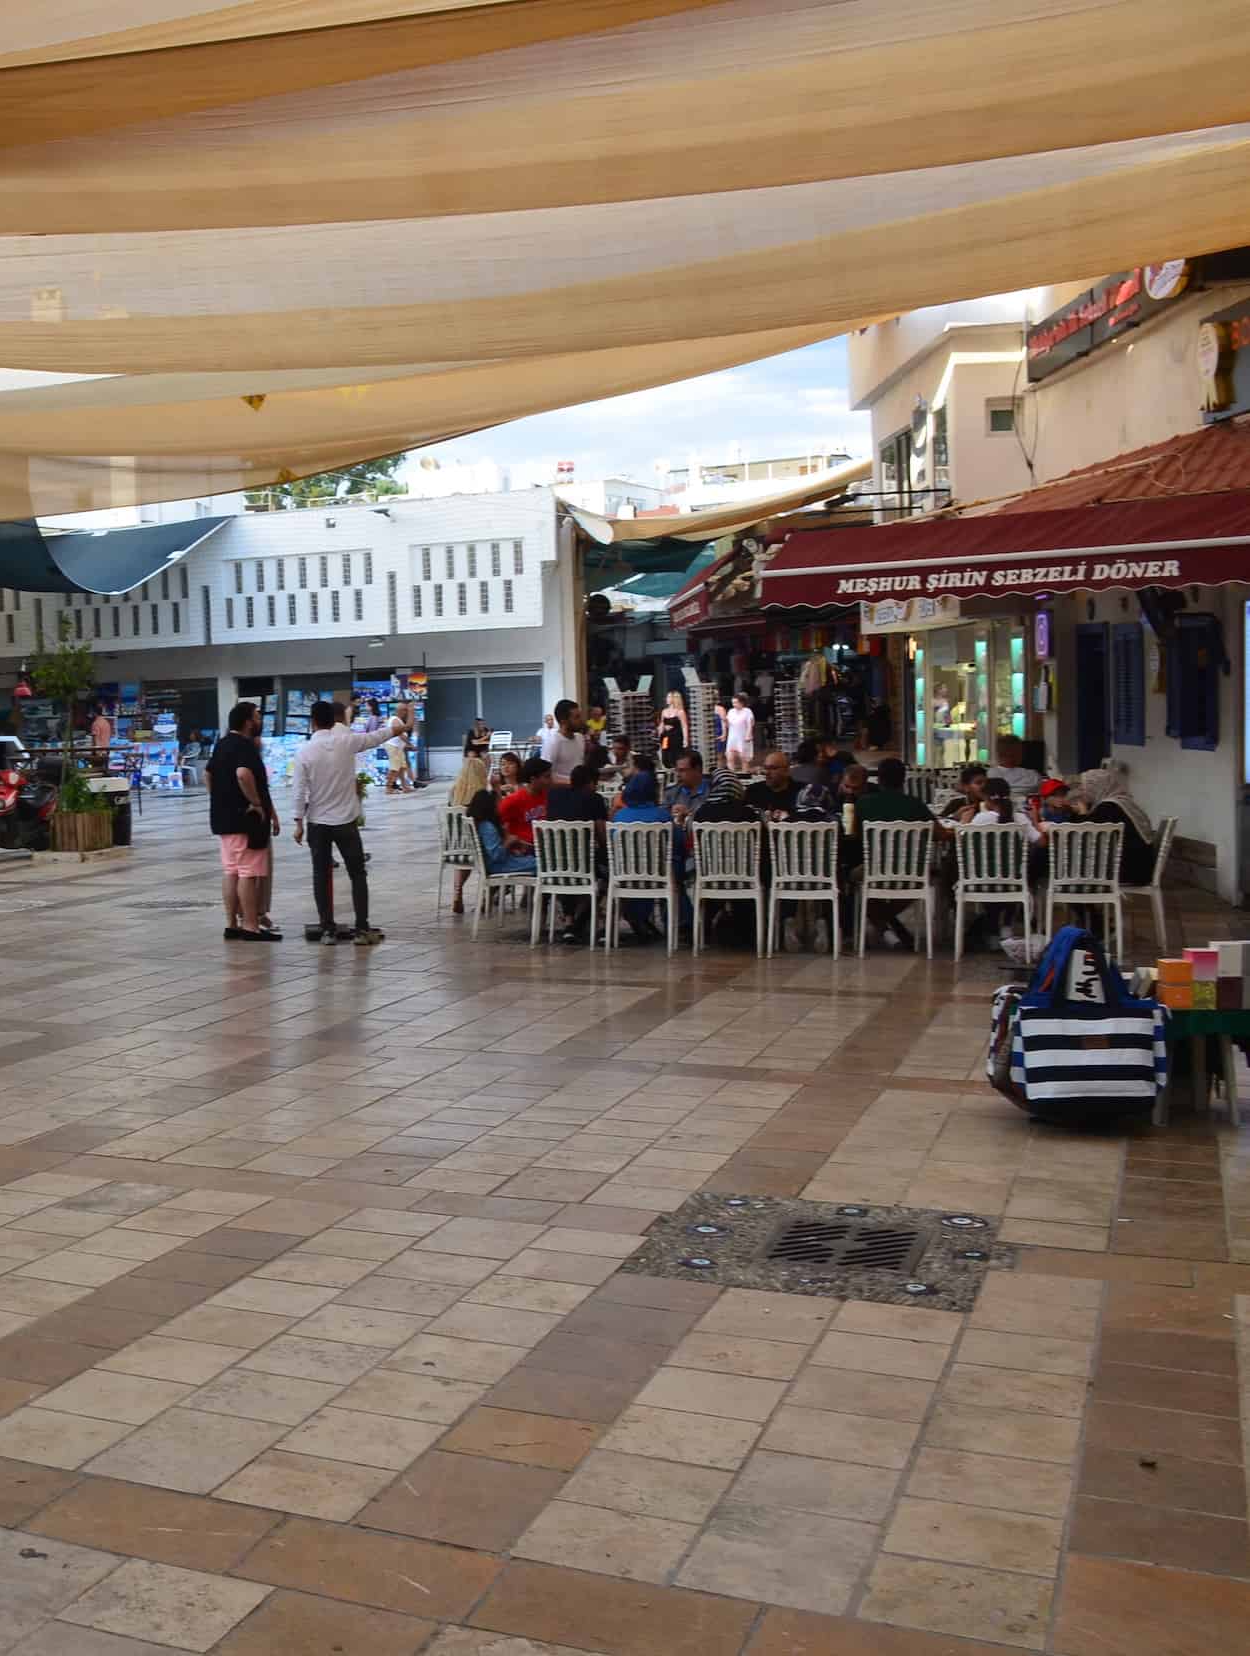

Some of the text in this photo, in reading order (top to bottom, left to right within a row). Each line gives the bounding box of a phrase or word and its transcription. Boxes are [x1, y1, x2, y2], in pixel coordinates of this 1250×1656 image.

[836, 559, 1180, 595] MEŞHUR ŞİRİN SEBZELİ DÖNER
